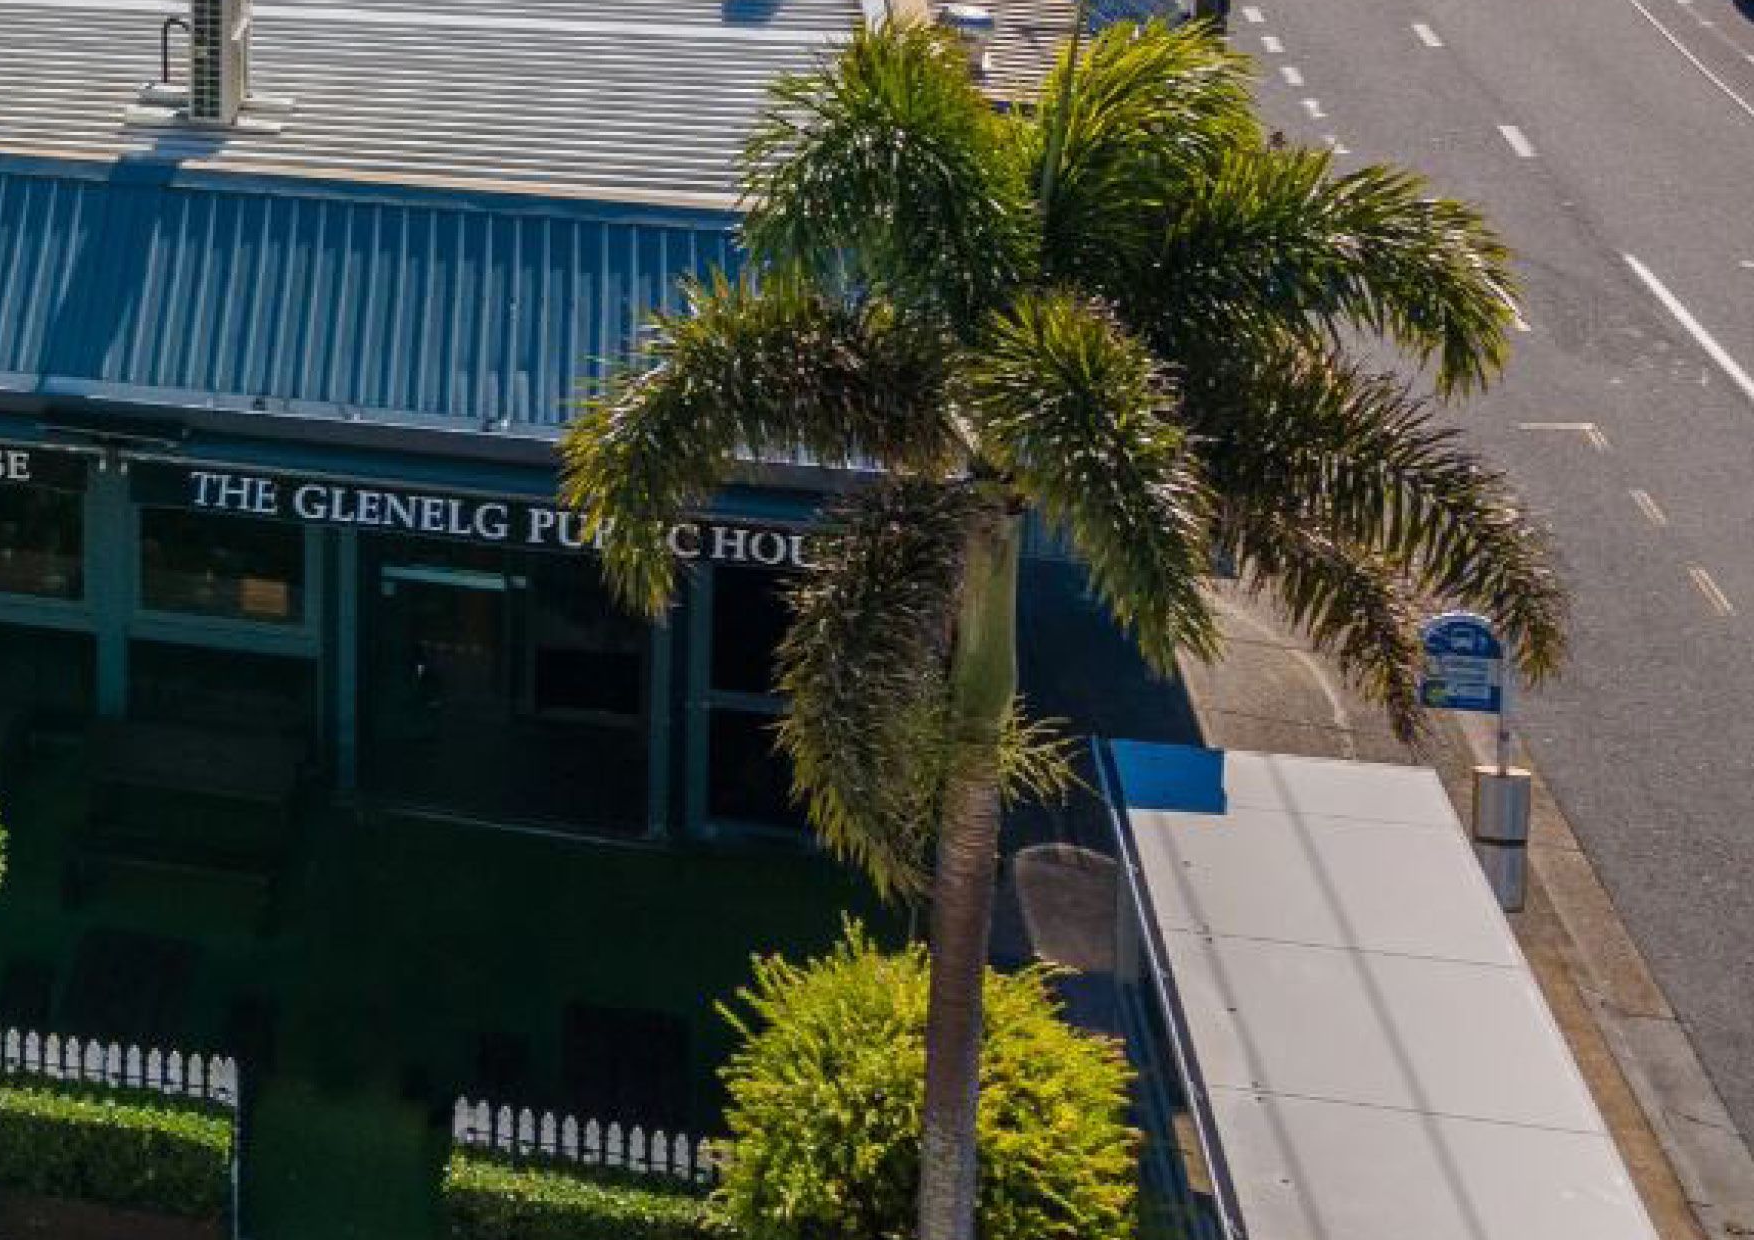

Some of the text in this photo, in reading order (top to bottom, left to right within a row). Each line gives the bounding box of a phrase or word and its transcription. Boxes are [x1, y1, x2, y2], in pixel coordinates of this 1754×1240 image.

[190, 471, 277, 515] THE
[292, 485, 508, 539] GLENELG
[525, 507, 701, 559] PUBC
